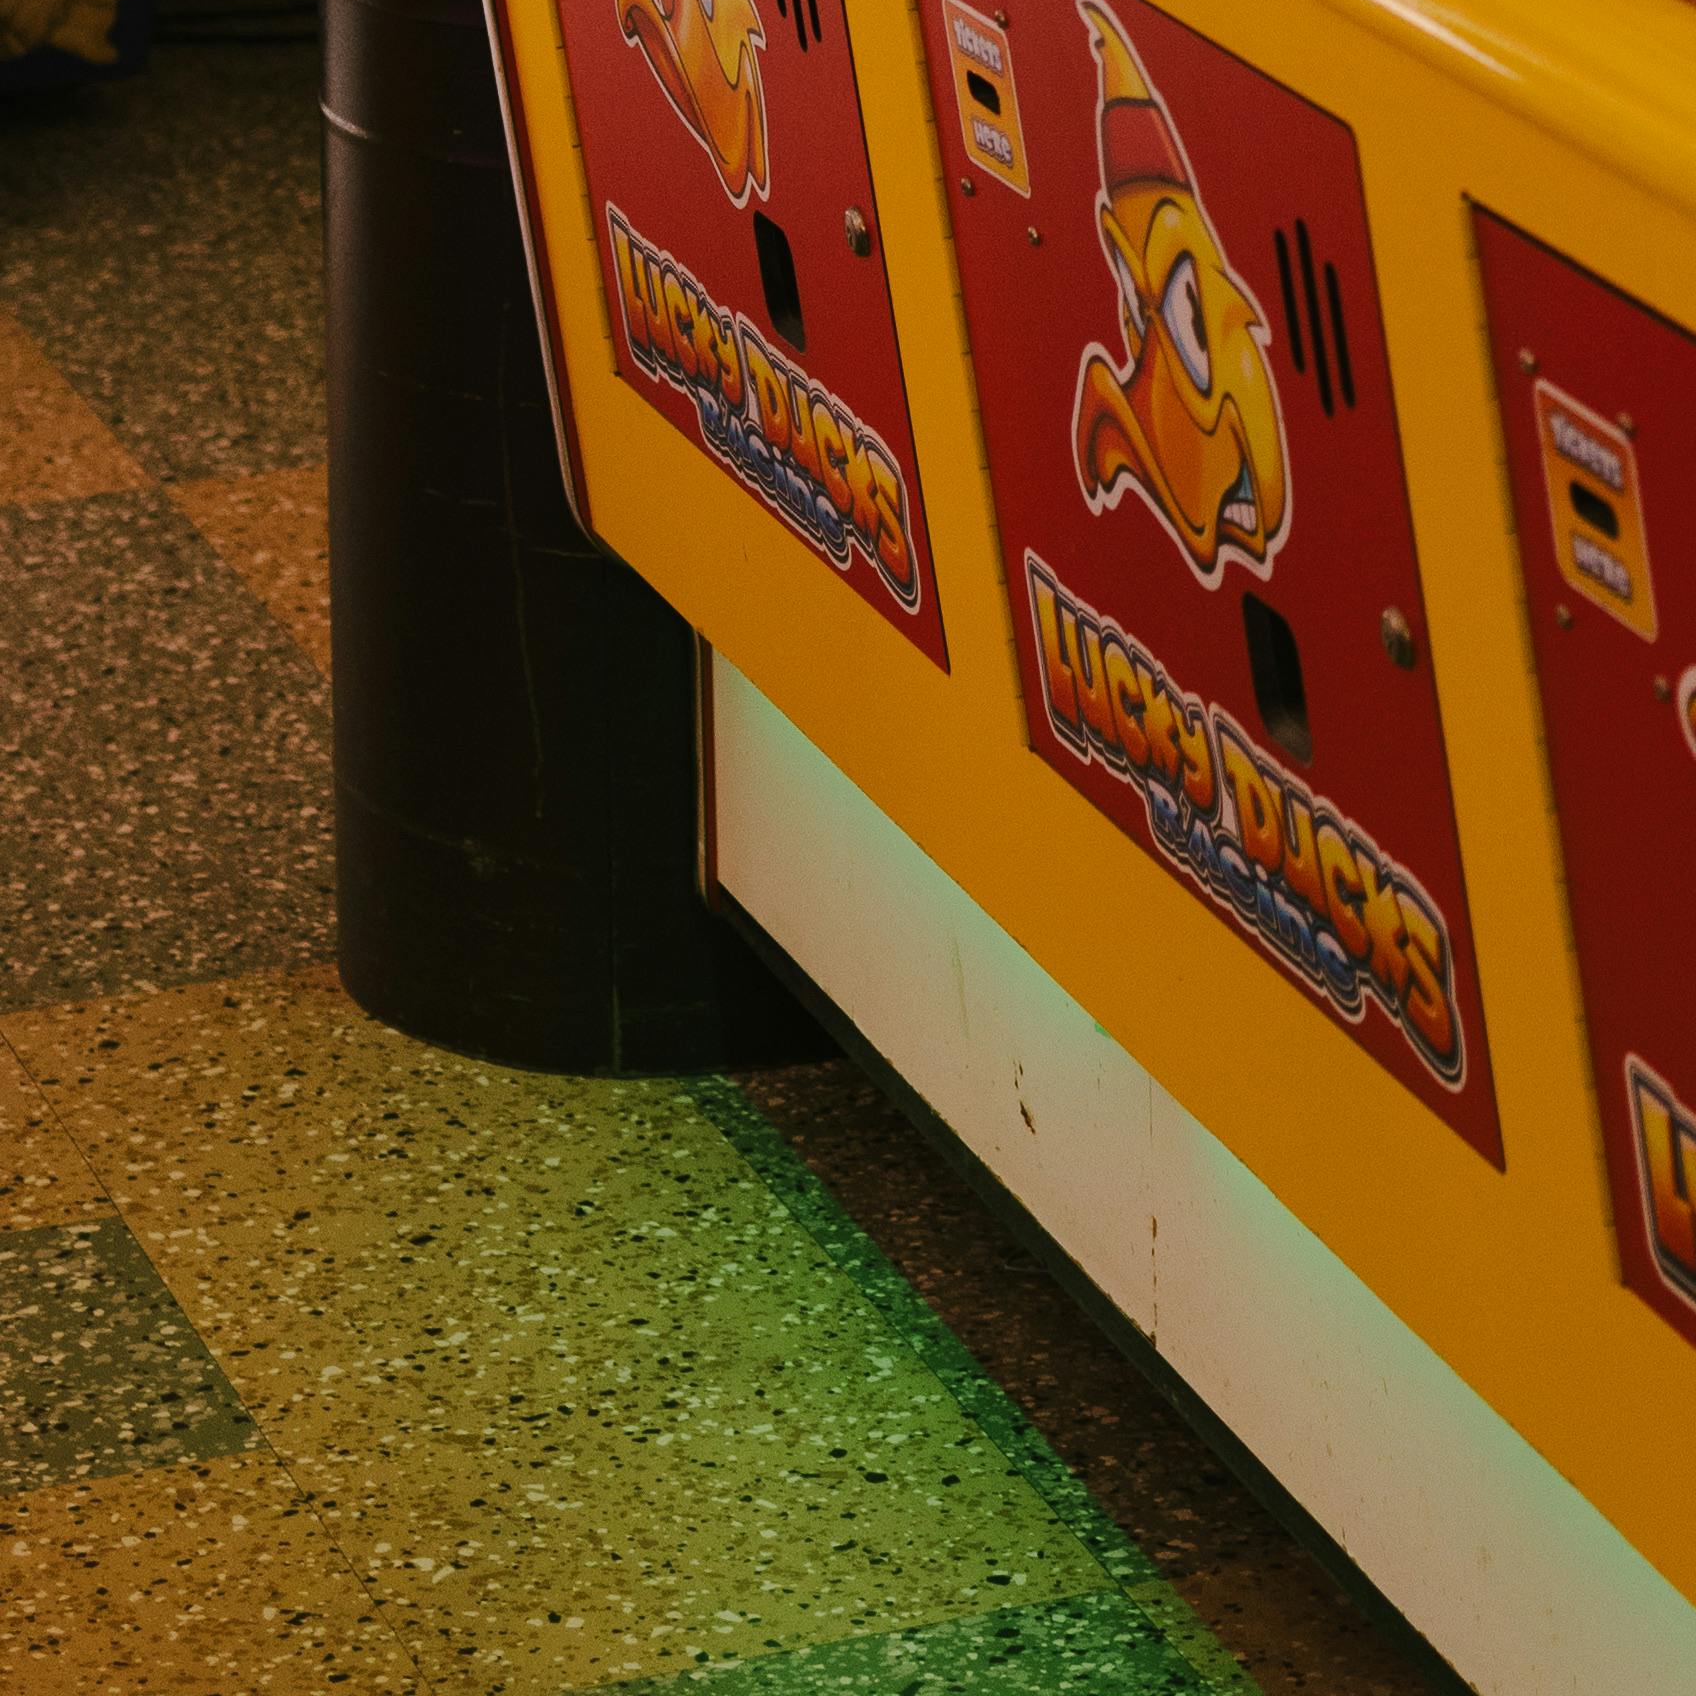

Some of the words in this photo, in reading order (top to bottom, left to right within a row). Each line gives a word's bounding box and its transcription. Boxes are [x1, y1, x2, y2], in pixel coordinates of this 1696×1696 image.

[608, 210, 746, 408] LUCKY
[742, 320, 914, 588] DUCKS
[1029, 568, 1217, 811] LUCKY
[1215, 720, 1453, 1057] DUCKS
